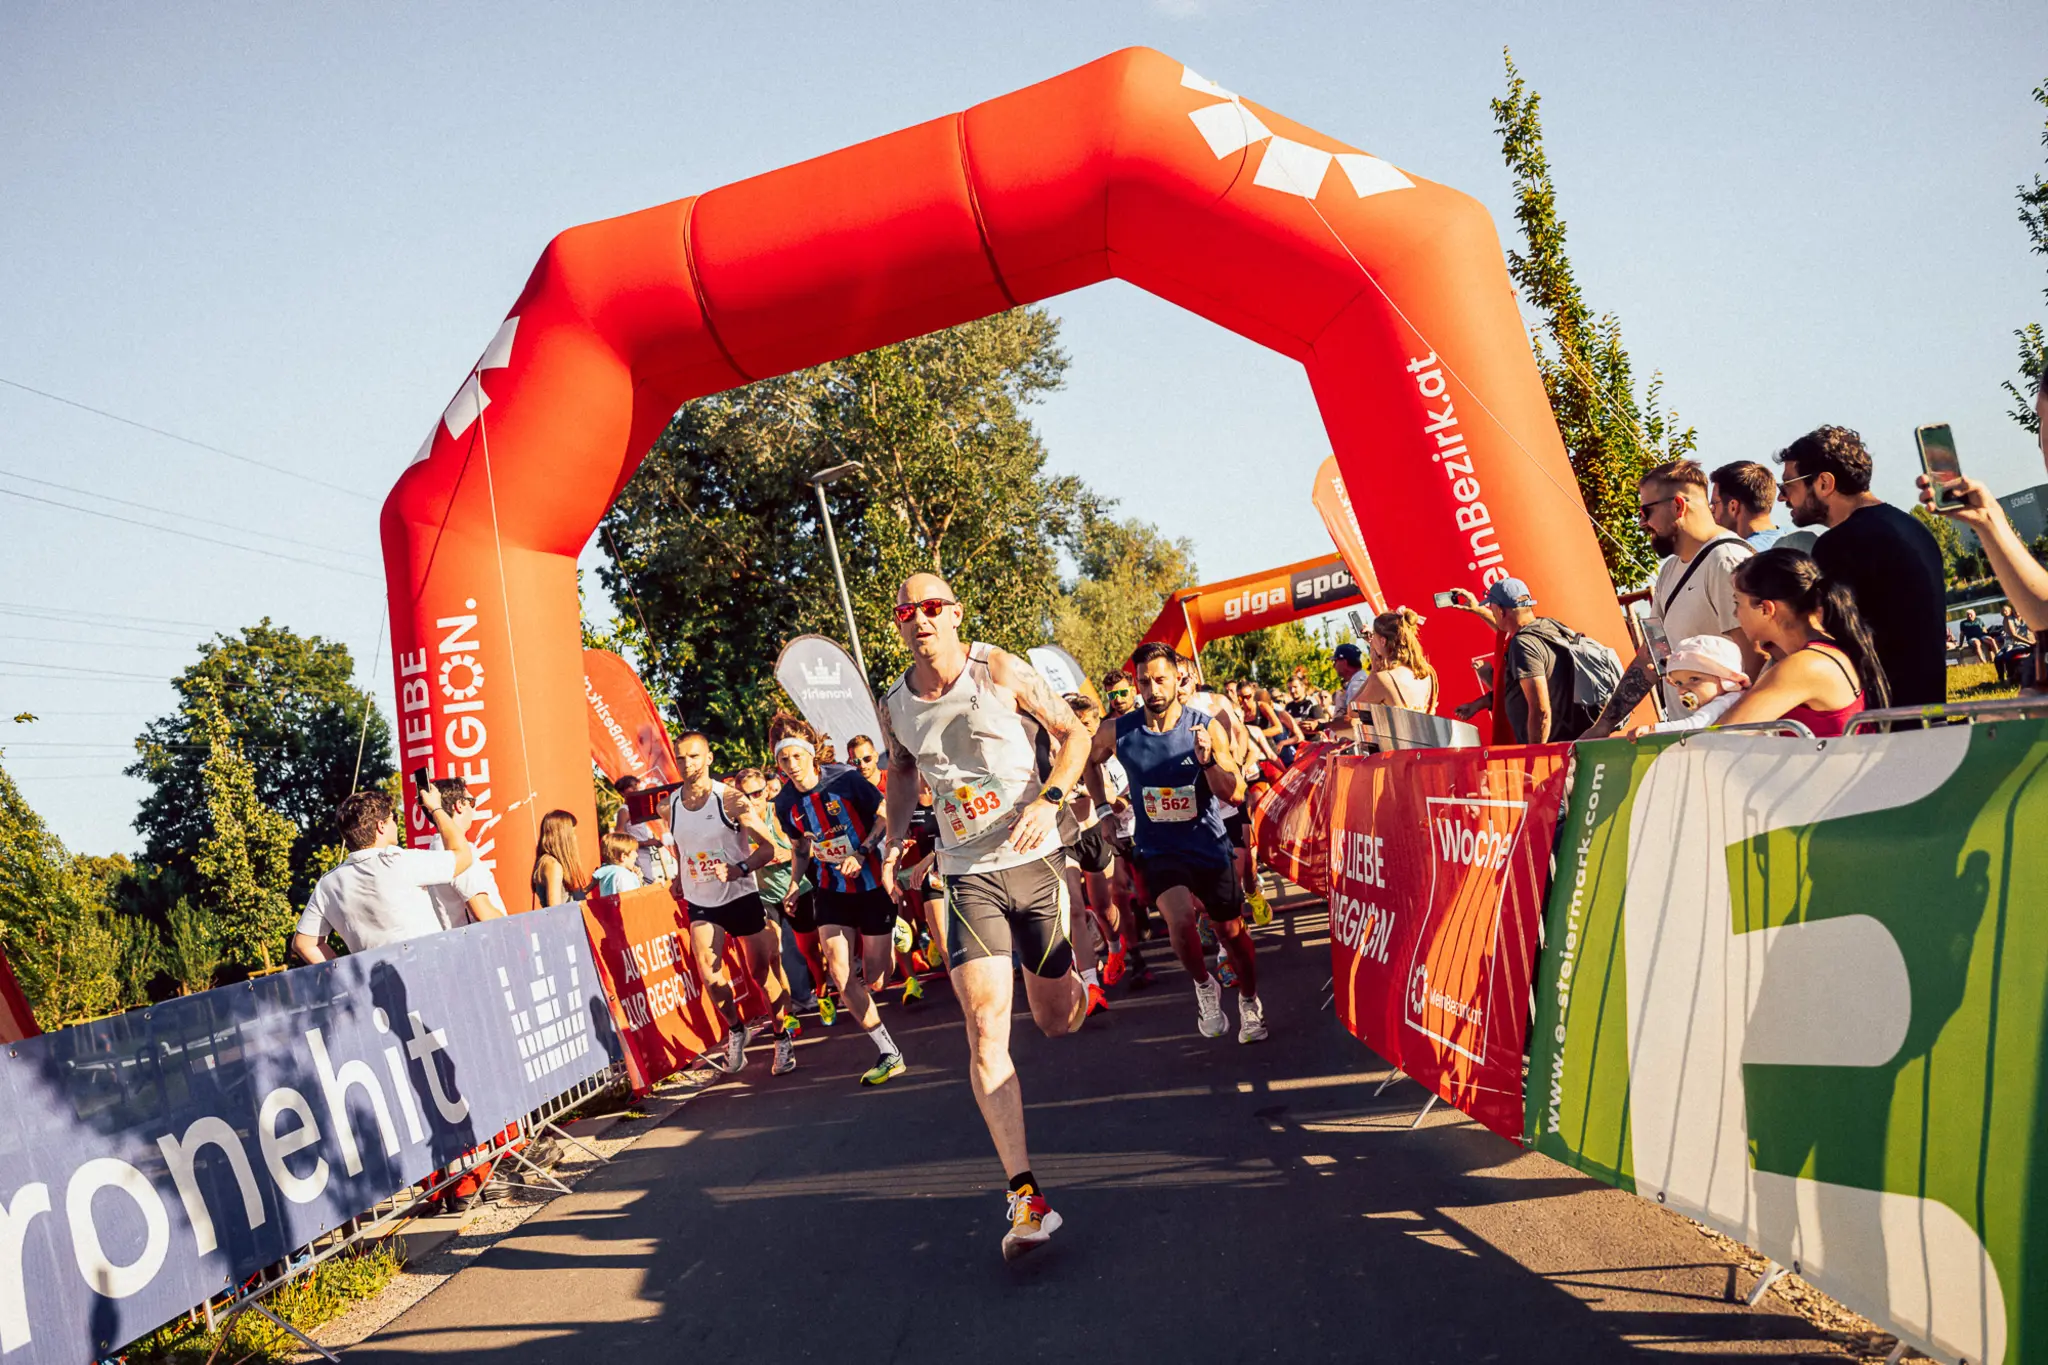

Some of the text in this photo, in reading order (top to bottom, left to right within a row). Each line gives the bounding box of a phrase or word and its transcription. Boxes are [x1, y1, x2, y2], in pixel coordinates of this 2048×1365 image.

[1407, 352, 1510, 594] einBezirk.at
[1224, 569, 1358, 621] giga spo
[962, 791, 1001, 820] 593
[1161, 797, 1190, 810] 562
[826, 845, 847, 857] 447
[1346, 831, 1385, 889] LIEBE
[1437, 818, 1512, 871] Woche
[621, 931, 682, 984] AUS LIEBE
[1547, 763, 1605, 1133] www.e-steiermark.com
[621, 969, 701, 1032] ZUR REGION.
